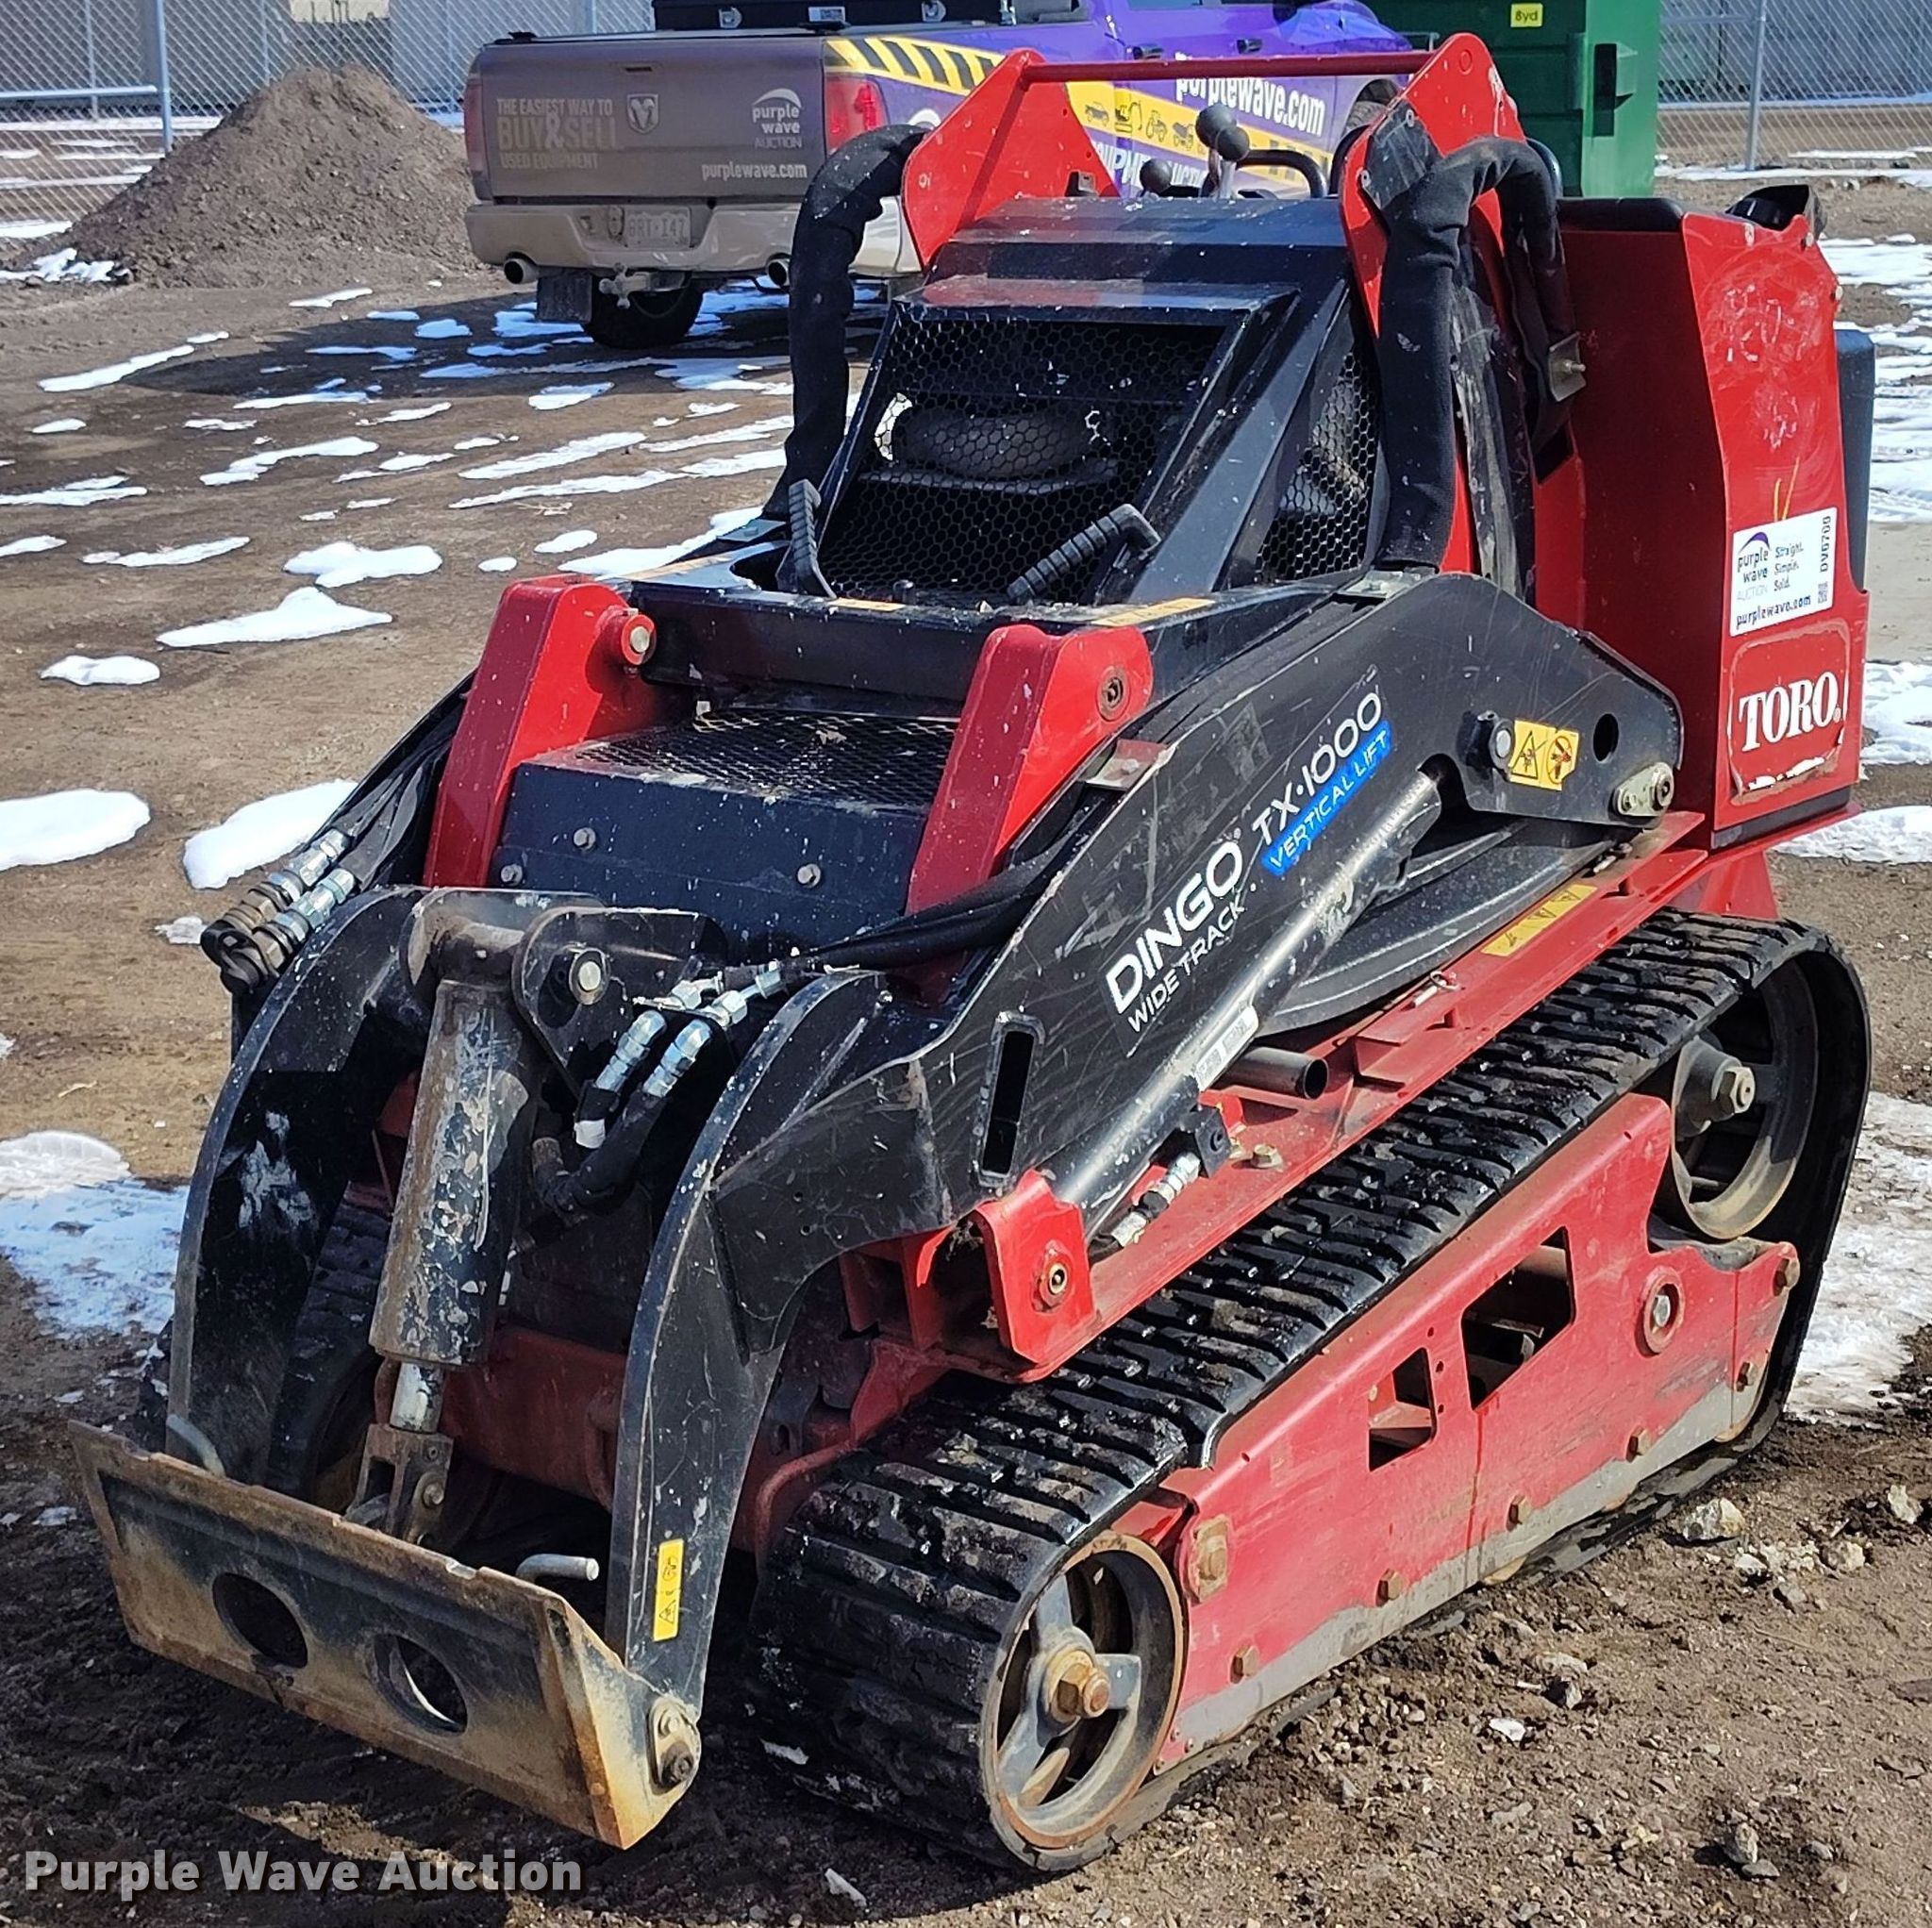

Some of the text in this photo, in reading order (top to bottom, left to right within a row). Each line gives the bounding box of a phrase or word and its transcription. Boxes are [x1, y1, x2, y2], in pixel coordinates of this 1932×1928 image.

[1515, 9, 1539, 24] 8yd
[497, 98, 613, 115] THE EASIEST WAY TO
[752, 103, 800, 123] purple
[761, 122, 801, 134] wave
[755, 137, 803, 149] AUCTION
[499, 152, 531, 169] USED
[701, 161, 808, 181] purplewave.com
[1738, 546, 1769, 573] purple
[1743, 568, 1768, 583] wave
[1736, 595, 1811, 630] purplewave.com
[1270, 729, 1388, 868] VERTICAL LIFT
[1106, 841, 1243, 1013] DINGO
[1128, 969, 1180, 1033] WIDE
[1179, 890, 1245, 975] TRACK
